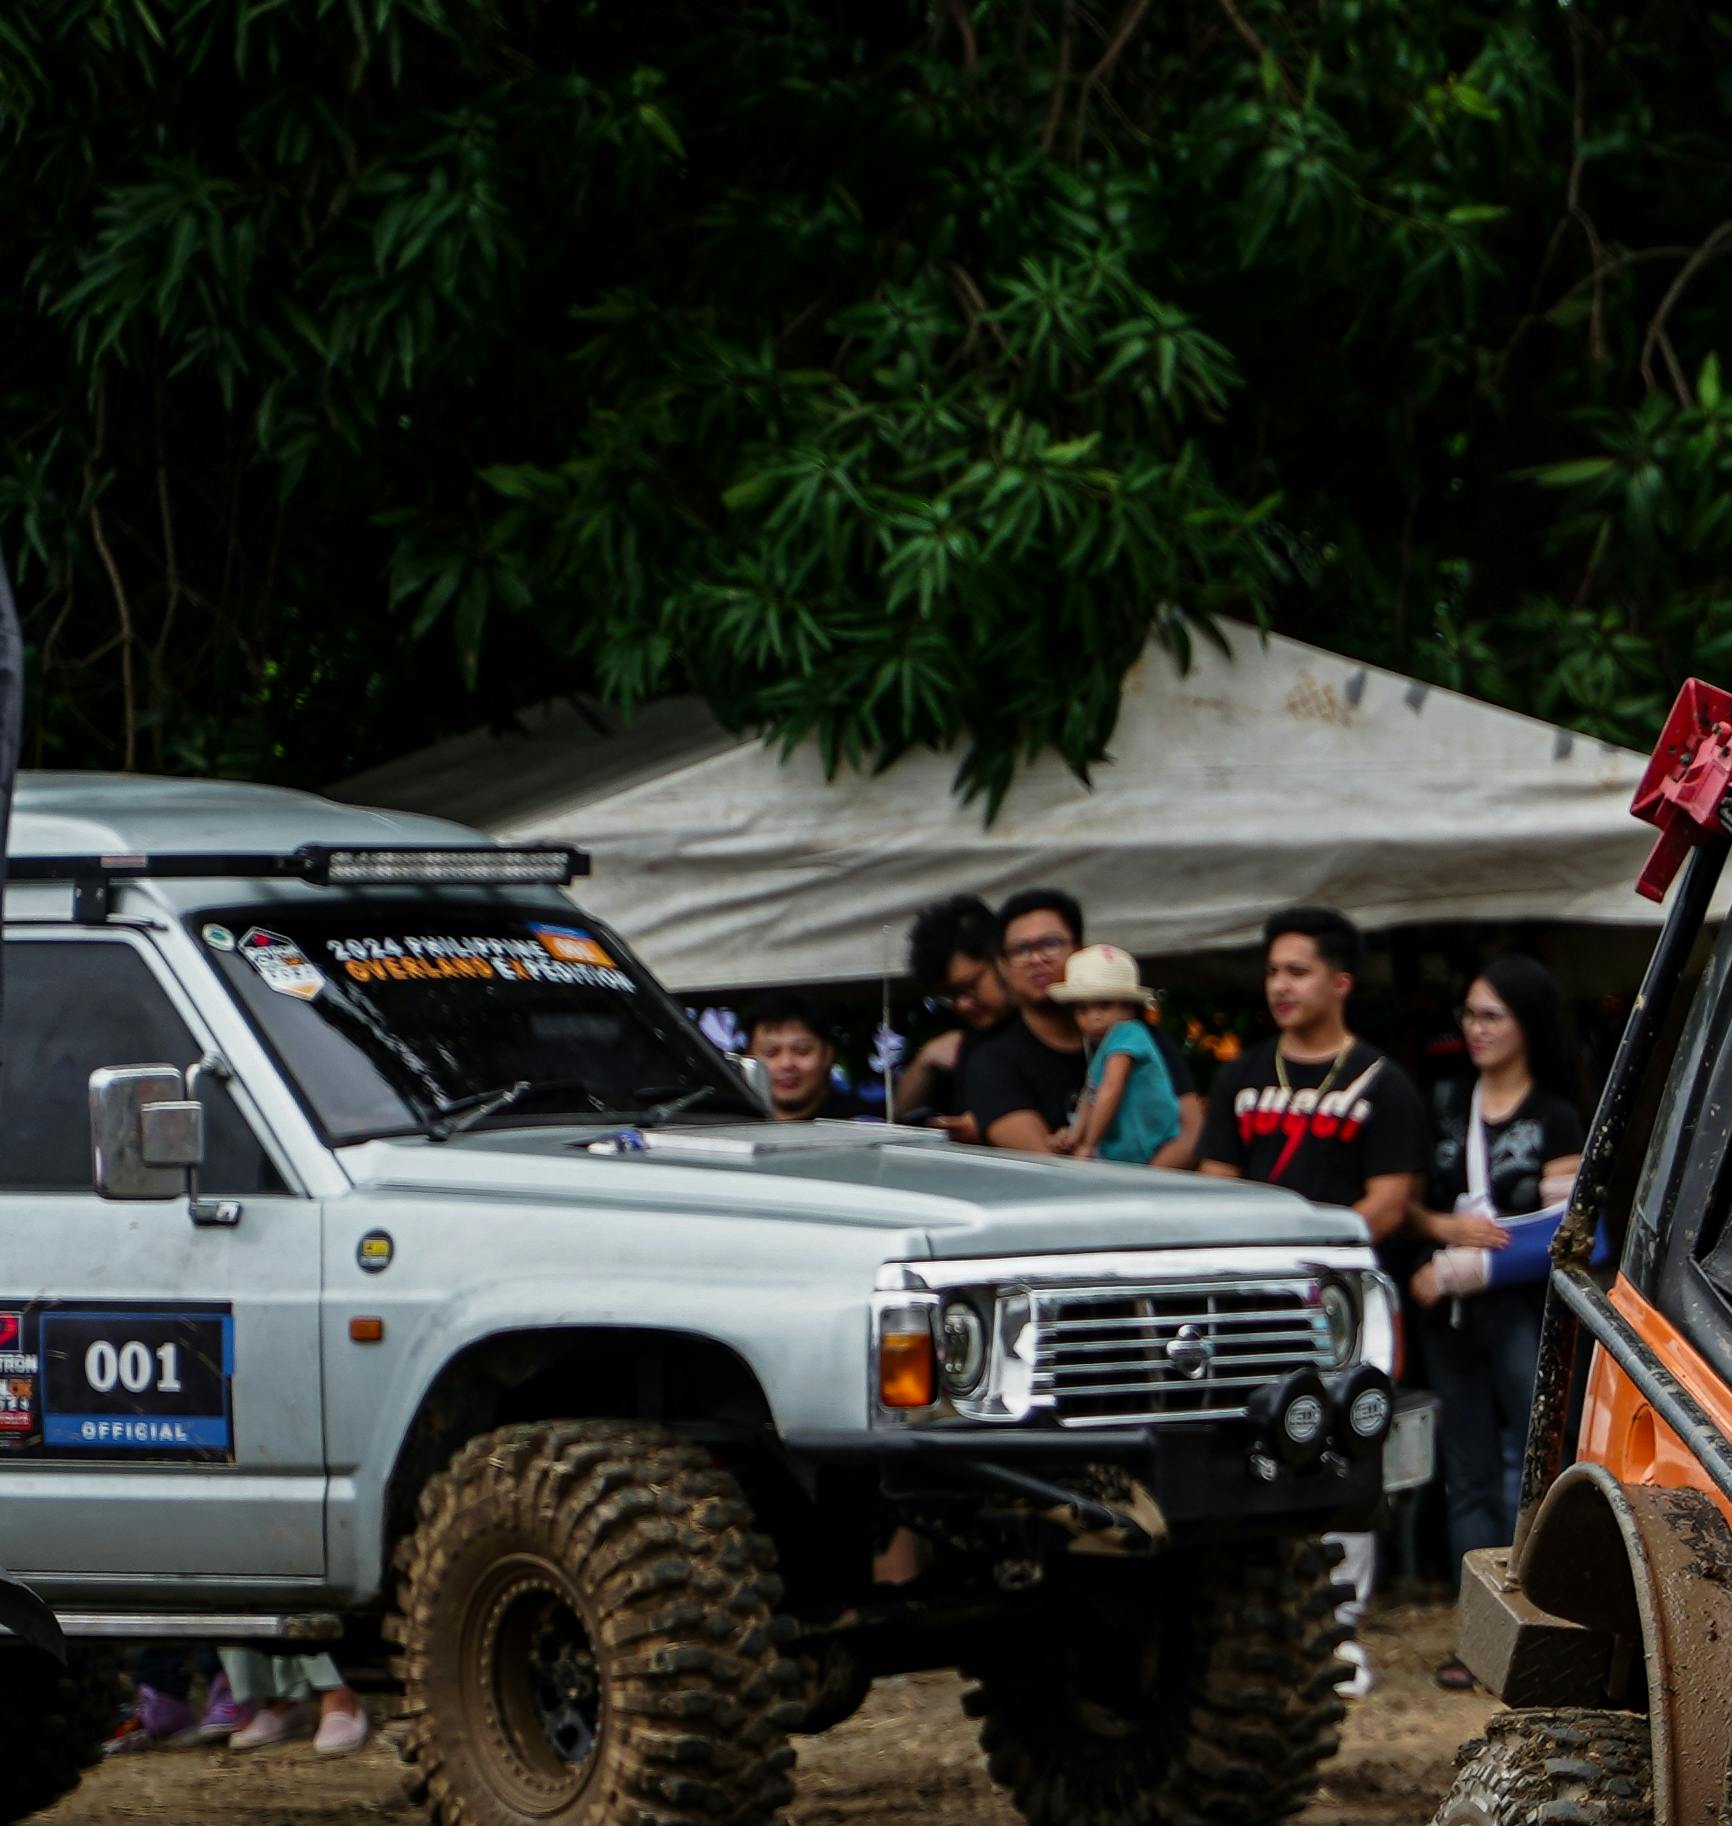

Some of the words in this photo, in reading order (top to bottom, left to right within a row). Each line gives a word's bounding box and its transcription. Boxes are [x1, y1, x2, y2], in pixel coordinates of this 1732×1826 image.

[326, 938, 402, 961] 2024
[402, 936, 550, 961] PHILIPPINE
[345, 956, 495, 983] OVERLAND
[490, 956, 637, 994] EXPEDITION
[85, 1340, 182, 1393] 001
[80, 1420, 188, 1442] OFFICIAL
